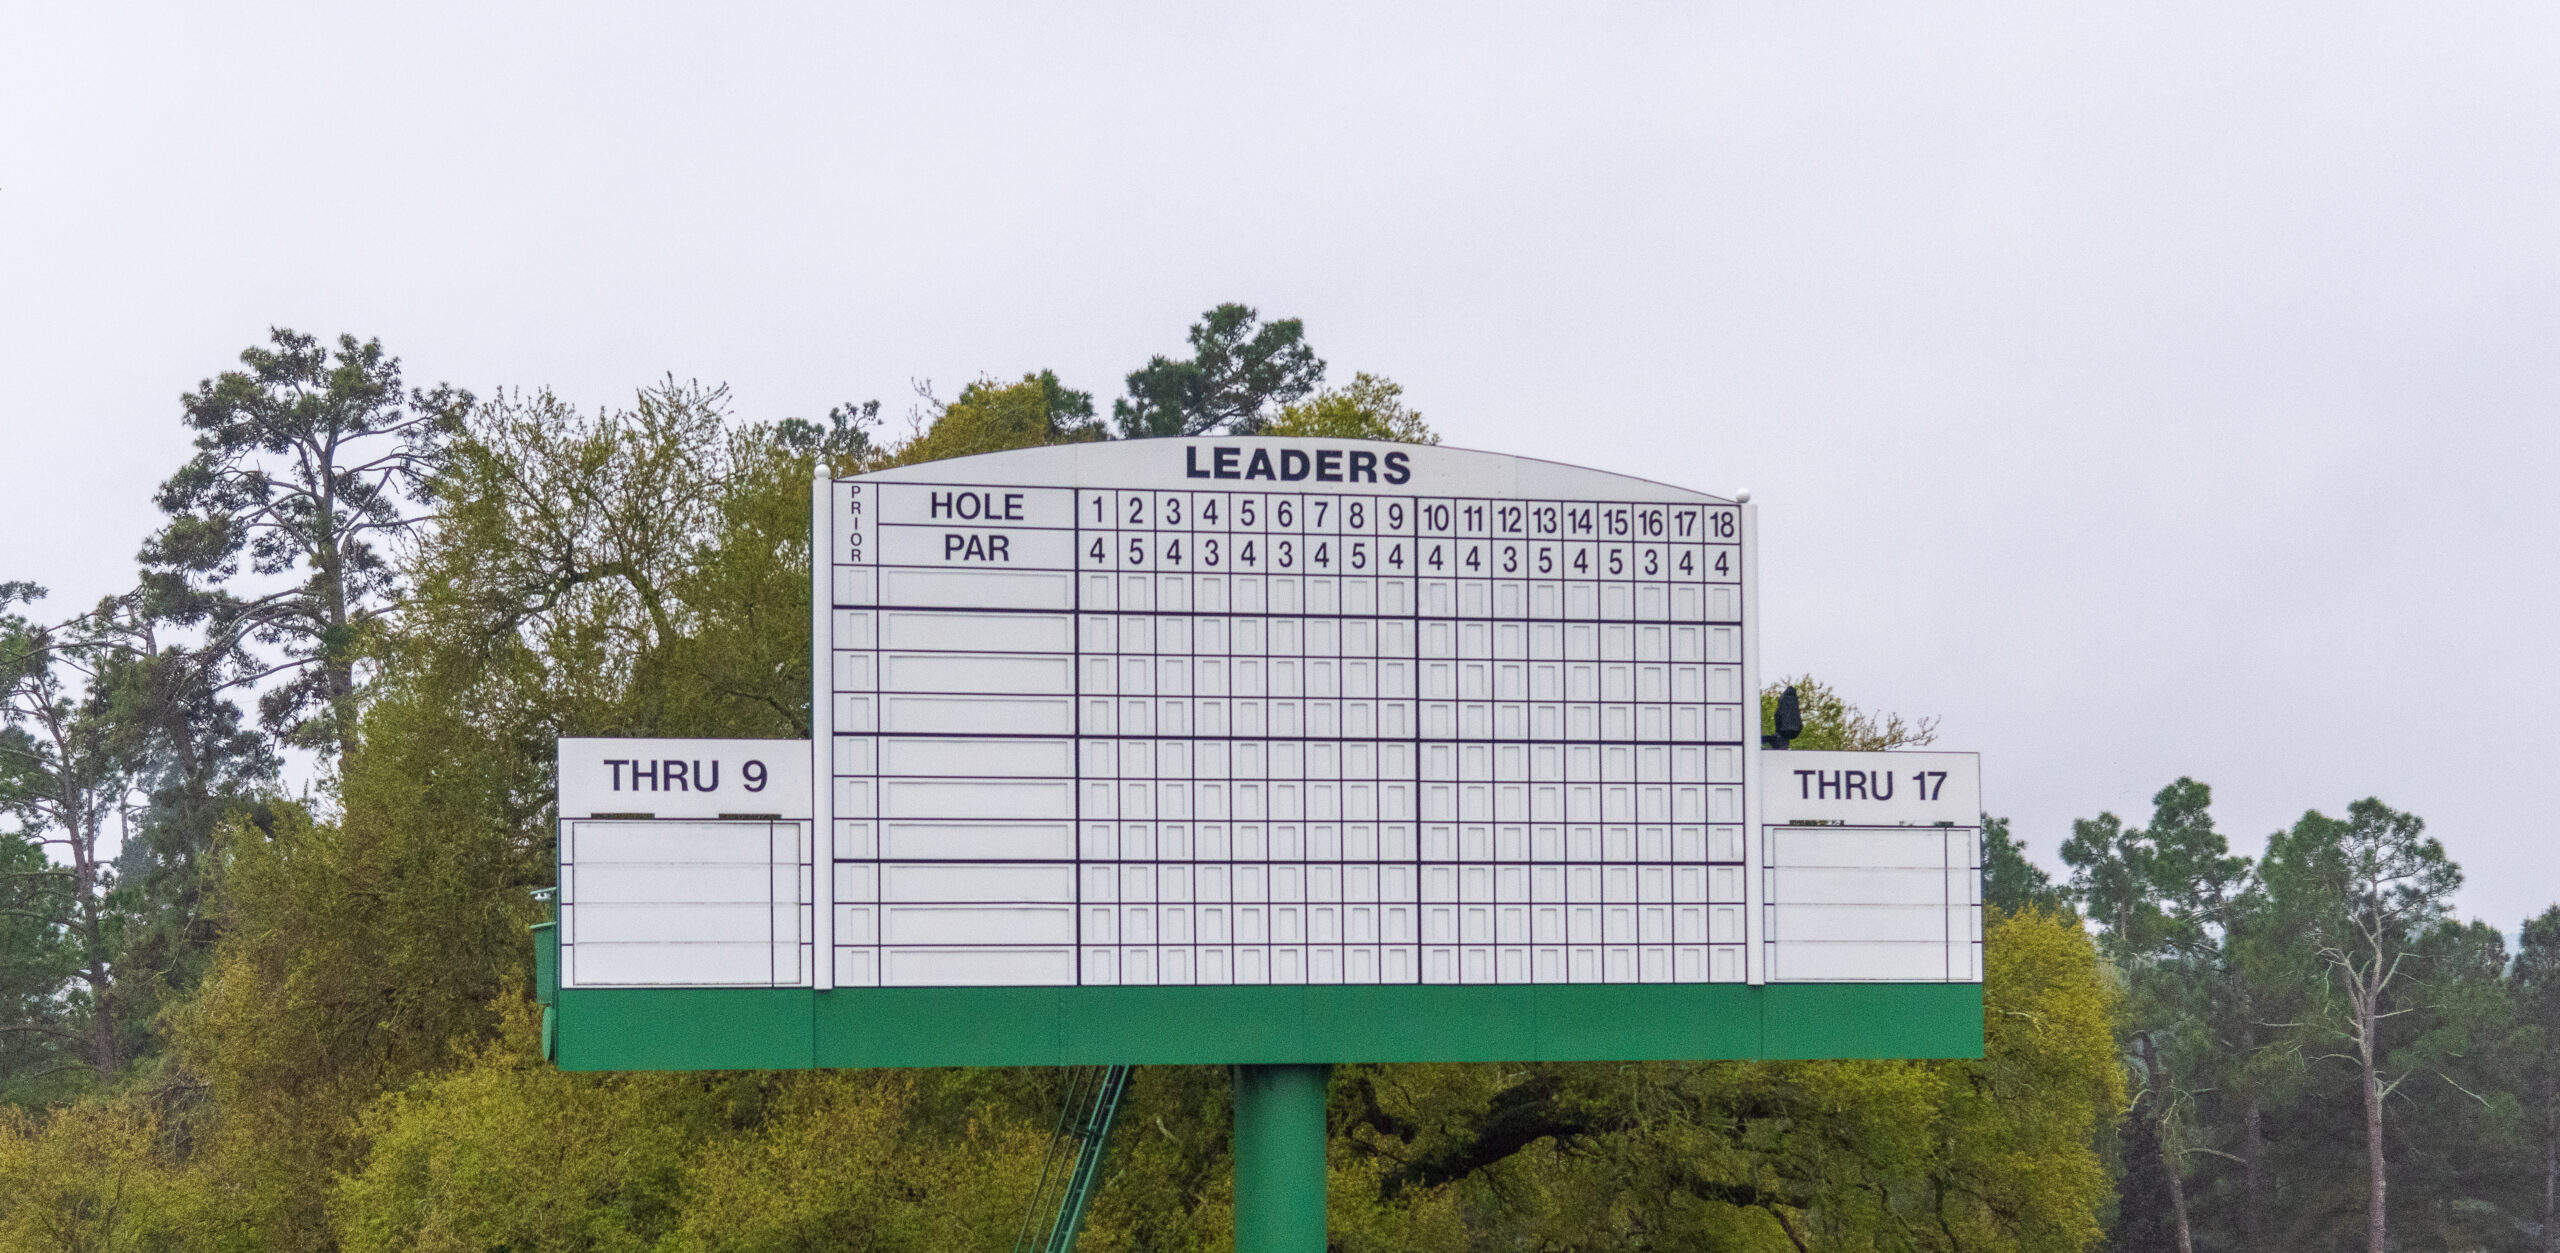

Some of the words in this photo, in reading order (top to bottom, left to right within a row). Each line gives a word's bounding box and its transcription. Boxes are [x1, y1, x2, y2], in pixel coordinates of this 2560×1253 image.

[1186, 445, 1411, 485] LEADERS
[850, 485, 863, 562] PRIOR
[931, 491, 1024, 521] HOLE
[1092, 496, 1102, 523] 1
[1129, 496, 1144, 524] 2
[1166, 498, 1181, 525] 3
[1203, 498, 1219, 526] 4
[1240, 499, 1256, 527] 5
[1277, 500, 1293, 528] 6
[1314, 501, 1329, 528] 7
[1349, 502, 1365, 529] 8
[1388, 502, 1404, 530] 9
[1423, 504, 1450, 532] 10
[1463, 505, 1483, 532] 11
[1497, 506, 1522, 533] 12
[1532, 507, 1557, 534] 13
[1567, 508, 1593, 535] 14
[1603, 509, 1629, 536] 15
[1638, 509, 1664, 537] 16
[1674, 510, 1697, 537] 17
[1709, 511, 1735, 539] 18
[944, 533, 1010, 562] PAR
[1089, 537, 1106, 564] 4
[1129, 537, 1144, 565] 5
[1166, 538, 1182, 566] 4
[1204, 539, 1220, 567] 3
[1240, 540, 1257, 567] 4
[1278, 540, 1293, 568] 3
[1314, 541, 1330, 568] 4
[1351, 542, 1366, 570] 5
[1388, 543, 1404, 570] 4
[1428, 544, 1444, 571] 4
[1465, 545, 1481, 572] 4
[1503, 545, 1518, 573] 3
[1538, 547, 1553, 574] 5
[1573, 548, 1589, 574] 4
[1609, 548, 1623, 575] 5
[1644, 548, 1659, 576] 3
[1679, 550, 1694, 576] 4
[1714, 550, 1730, 577] 4
[603, 759, 719, 793] THRU
[742, 759, 768, 793] 9
[1793, 769, 1894, 801] THRU
[1912, 771, 1948, 801] 17
